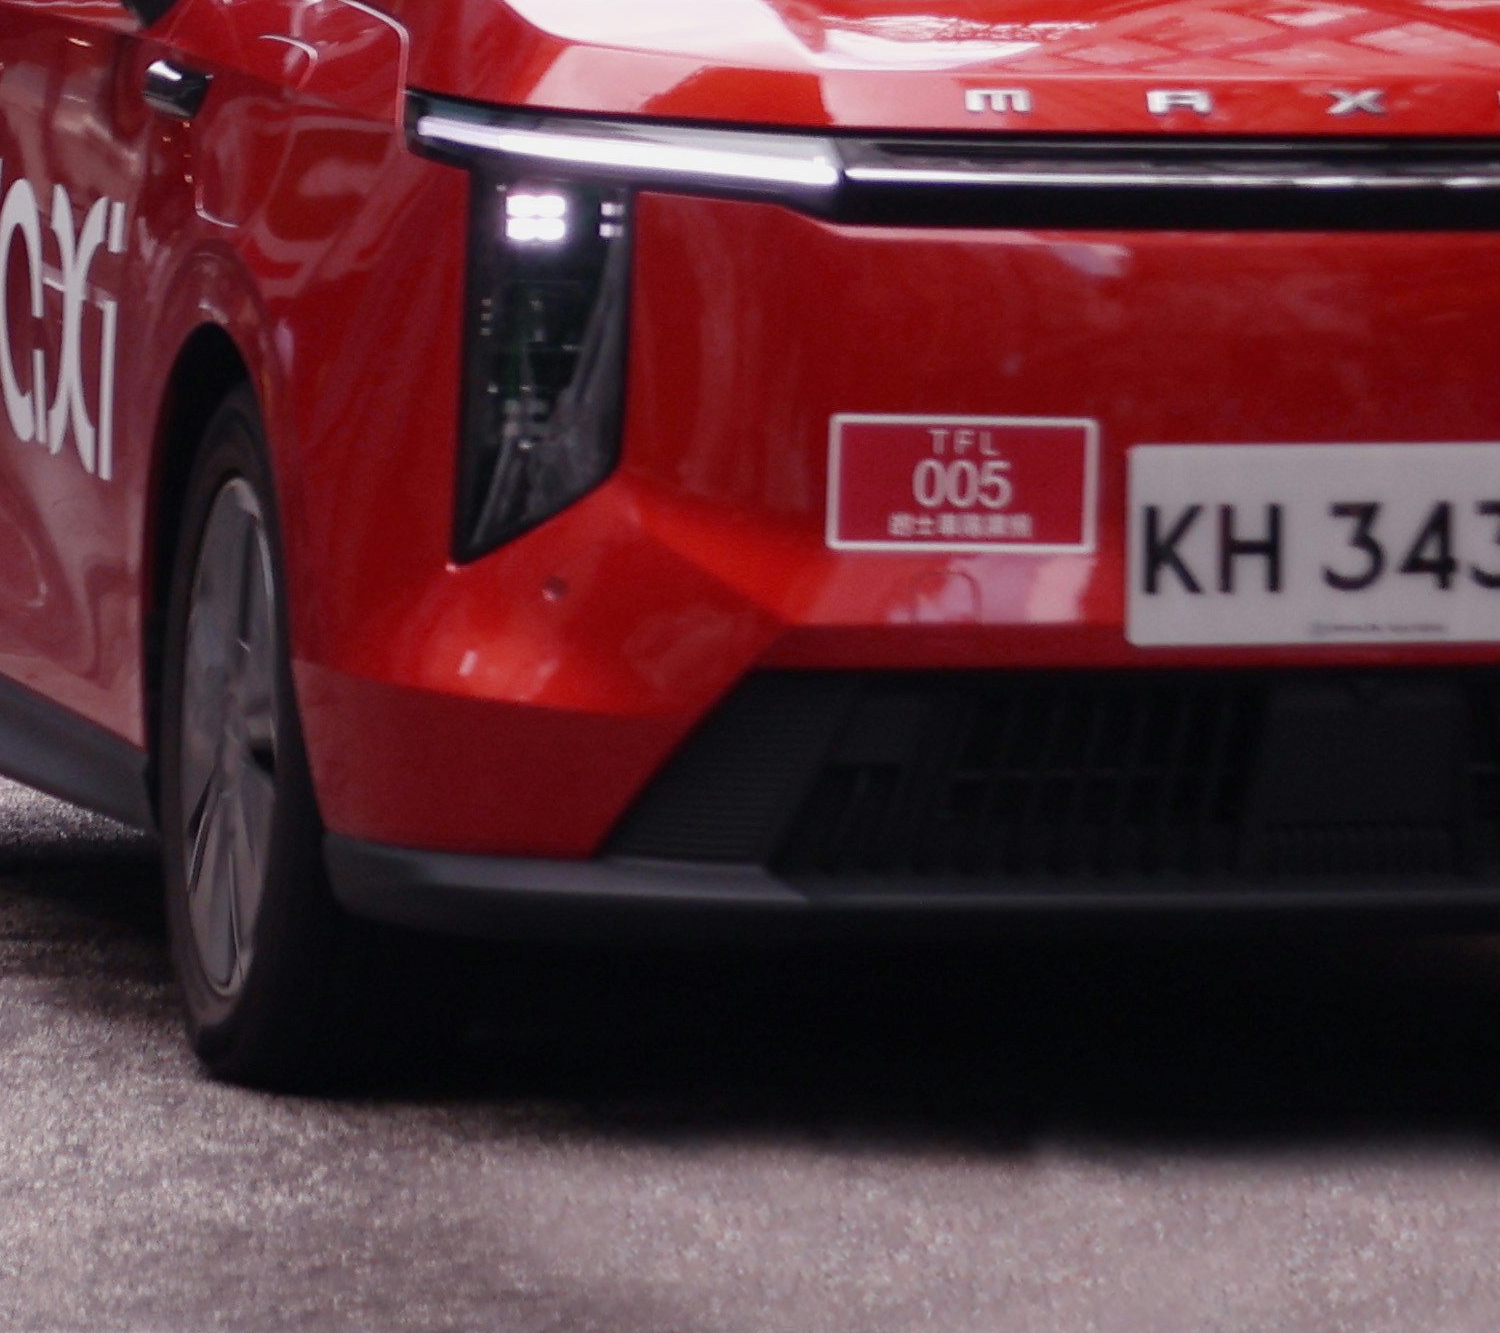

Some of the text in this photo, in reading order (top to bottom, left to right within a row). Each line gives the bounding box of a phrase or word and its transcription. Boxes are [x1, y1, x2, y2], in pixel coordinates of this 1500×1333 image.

[927, 428, 1000, 456] TFL
[912, 458, 1013, 509] 005
[1143, 504, 1286, 594] KH
